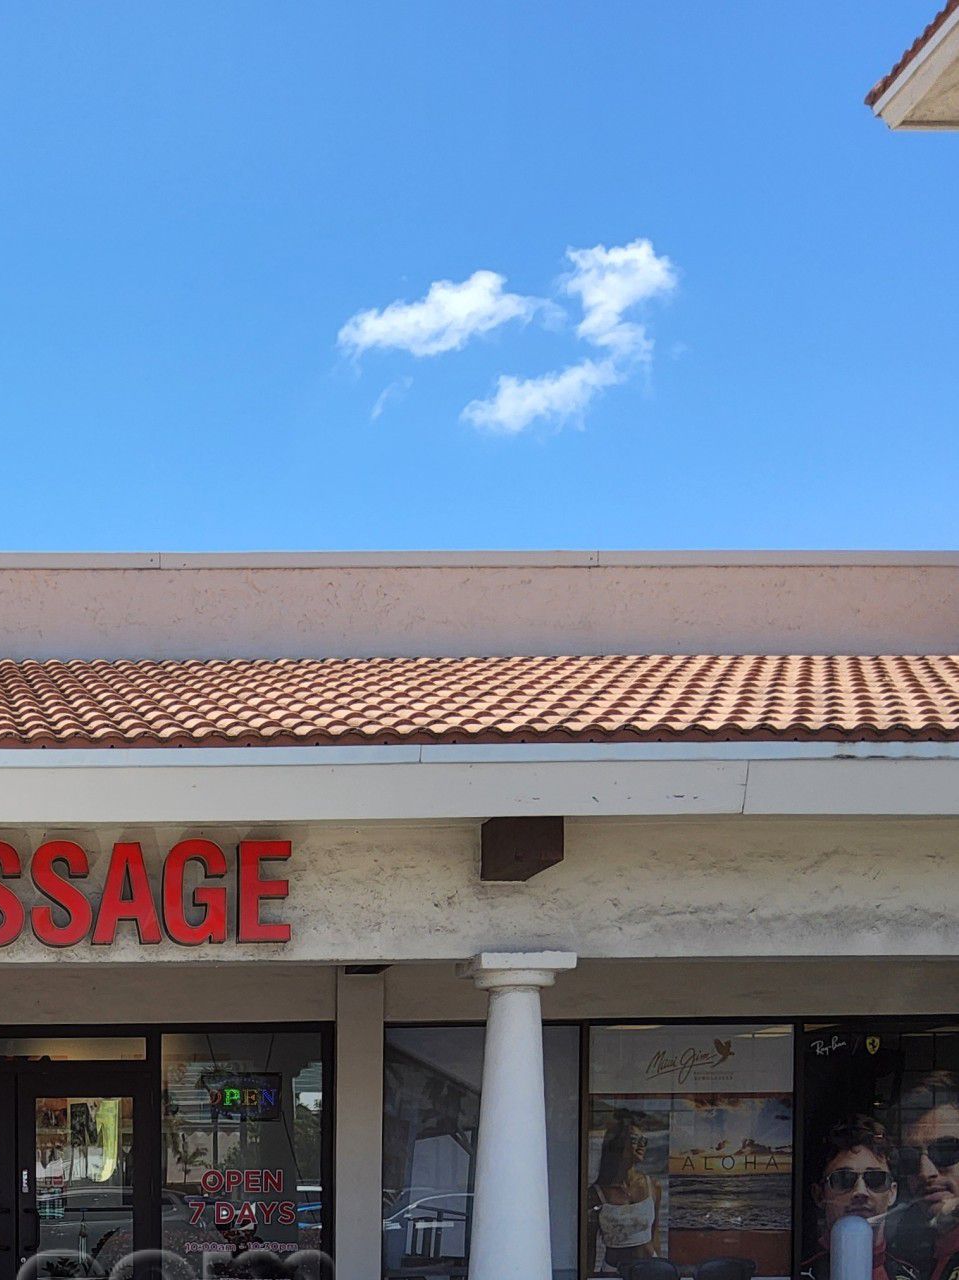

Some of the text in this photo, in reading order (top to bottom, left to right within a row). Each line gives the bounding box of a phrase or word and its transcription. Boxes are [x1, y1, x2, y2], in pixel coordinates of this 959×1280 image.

[209, 1088, 277, 1106] OPEN
[681, 1155, 780, 1171] ALOHA
[200, 1169, 284, 1193] OPEN
[189, 1201, 296, 1225] 7 DAYS
